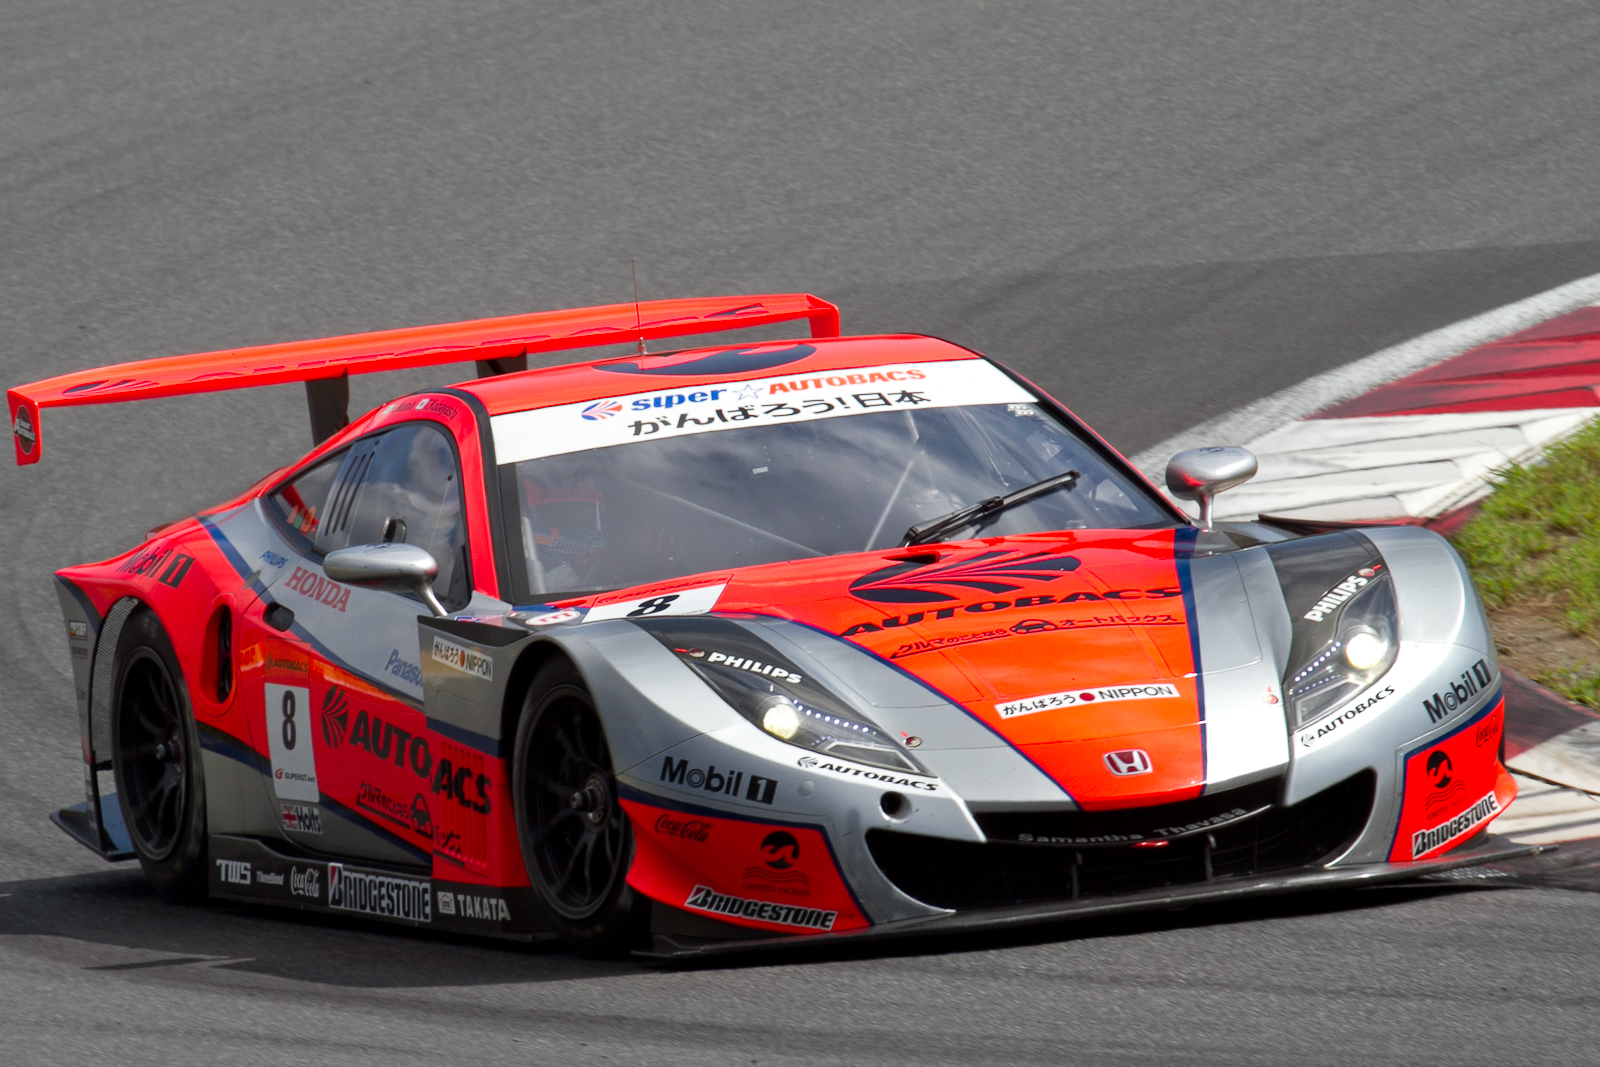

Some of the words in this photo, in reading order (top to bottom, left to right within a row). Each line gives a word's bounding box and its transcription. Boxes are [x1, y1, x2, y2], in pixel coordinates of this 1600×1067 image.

[632, 386, 728, 412] super
[769, 369, 926, 395] AUTOBACS
[627, 389, 931, 436] がんばろう!日本
[115, 547, 174, 578] Mobil
[258, 550, 289, 568] PHILIPS
[284, 566, 351, 613] HONDA
[626, 594, 680, 617] 8
[1304, 575, 1368, 622] PHILIPS
[839, 587, 1182, 637] AUTOBACS
[1059, 613, 1178, 628] オートバックス
[273, 658, 308, 673] AUTOBACS
[434, 641, 459, 665] がんばろう
[465, 653, 492, 678] NIPPON
[708, 651, 802, 684] PHILIPS
[1002, 693, 1077, 717] がんばろう
[1098, 685, 1174, 701] NIPPON
[1422, 670, 1478, 724] Mobil
[1473, 660, 1491, 688] 1
[281, 690, 296, 750] 8
[1317, 685, 1396, 738] AUTOBACS
[660, 756, 743, 797] Mobil
[818, 762, 939, 792] AUTOBACS
[296, 806, 321, 833] Holts
[1018, 832, 1143, 844] Samantha
[1153, 806, 1248, 837] Thavasa
[1413, 794, 1498, 857] BRIDGESTONE
[216, 859, 250, 884] TWS
[742, 882, 776, 893] UNITED
[778, 886, 811, 897] OCEAN
[328, 862, 431, 922] BRIDGESTONE
[457, 894, 512, 921] TAKATA
[686, 885, 836, 930] BRIDGESTONE
